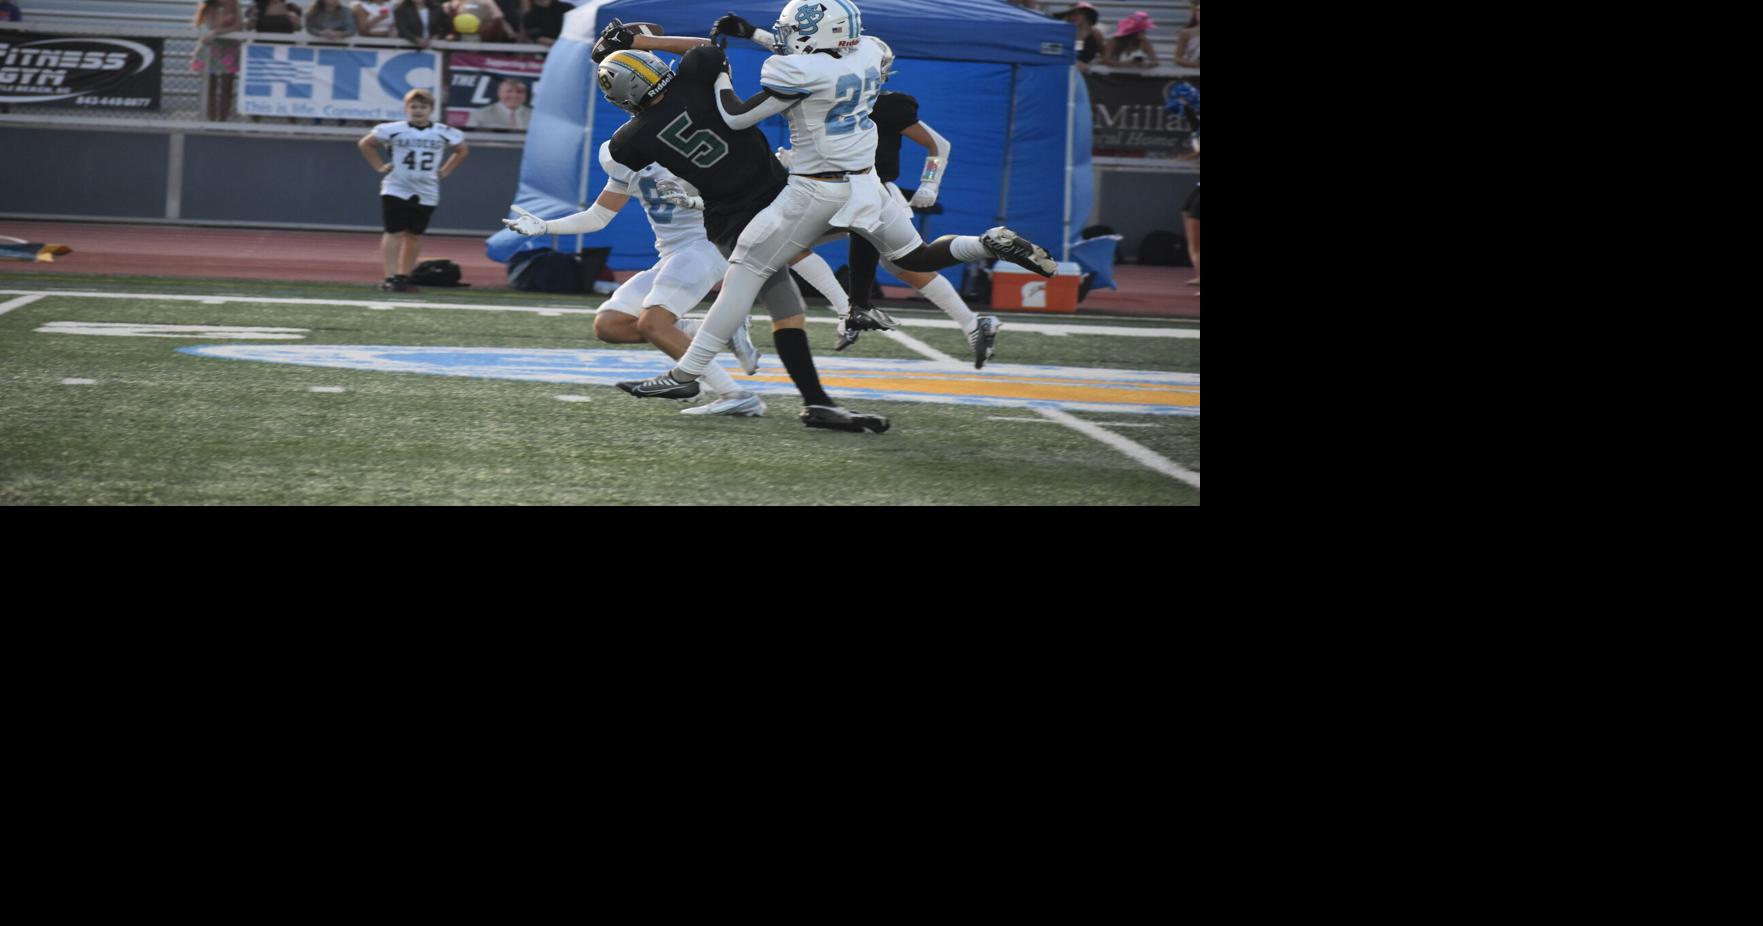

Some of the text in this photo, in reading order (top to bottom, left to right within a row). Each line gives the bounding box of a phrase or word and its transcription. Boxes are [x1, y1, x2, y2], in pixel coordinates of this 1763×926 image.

[244, 45, 436, 102] HTC
[647, 73, 676, 98] Riddell
[656, 110, 729, 168] 5
[401, 149, 434, 172] 42
